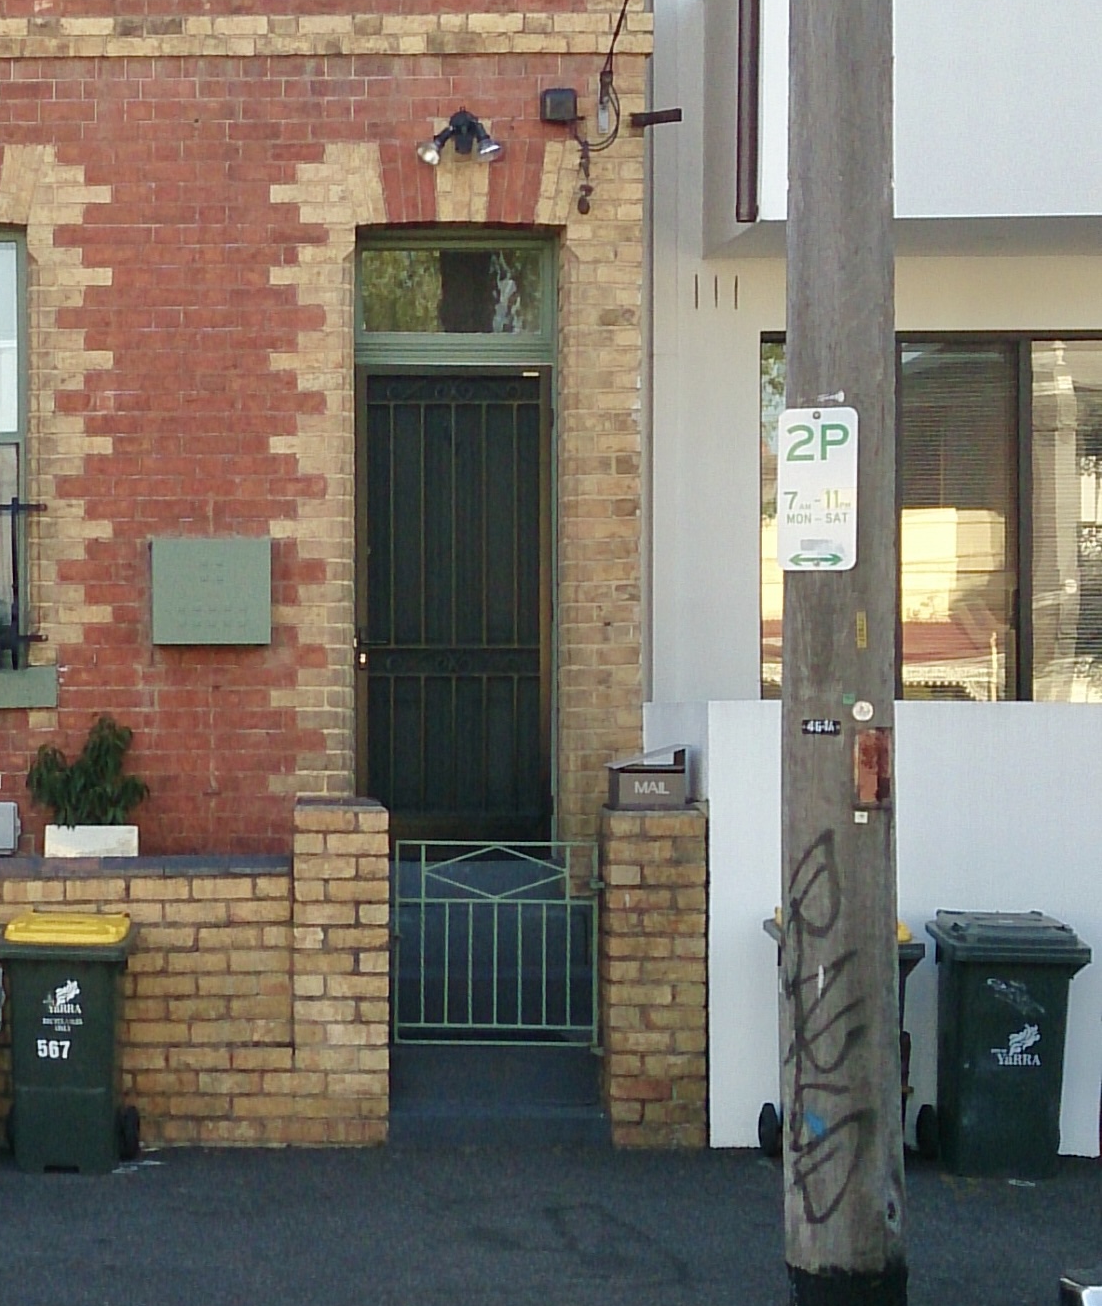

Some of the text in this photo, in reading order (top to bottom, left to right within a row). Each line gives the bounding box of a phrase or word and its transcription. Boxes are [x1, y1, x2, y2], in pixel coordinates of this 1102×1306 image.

[786, 423, 850, 461] 2P
[786, 513, 812, 525] MON
[825, 512, 848, 524] SAT
[634, 781, 670, 795] MAIL
[37, 1039, 71, 1059] 567
